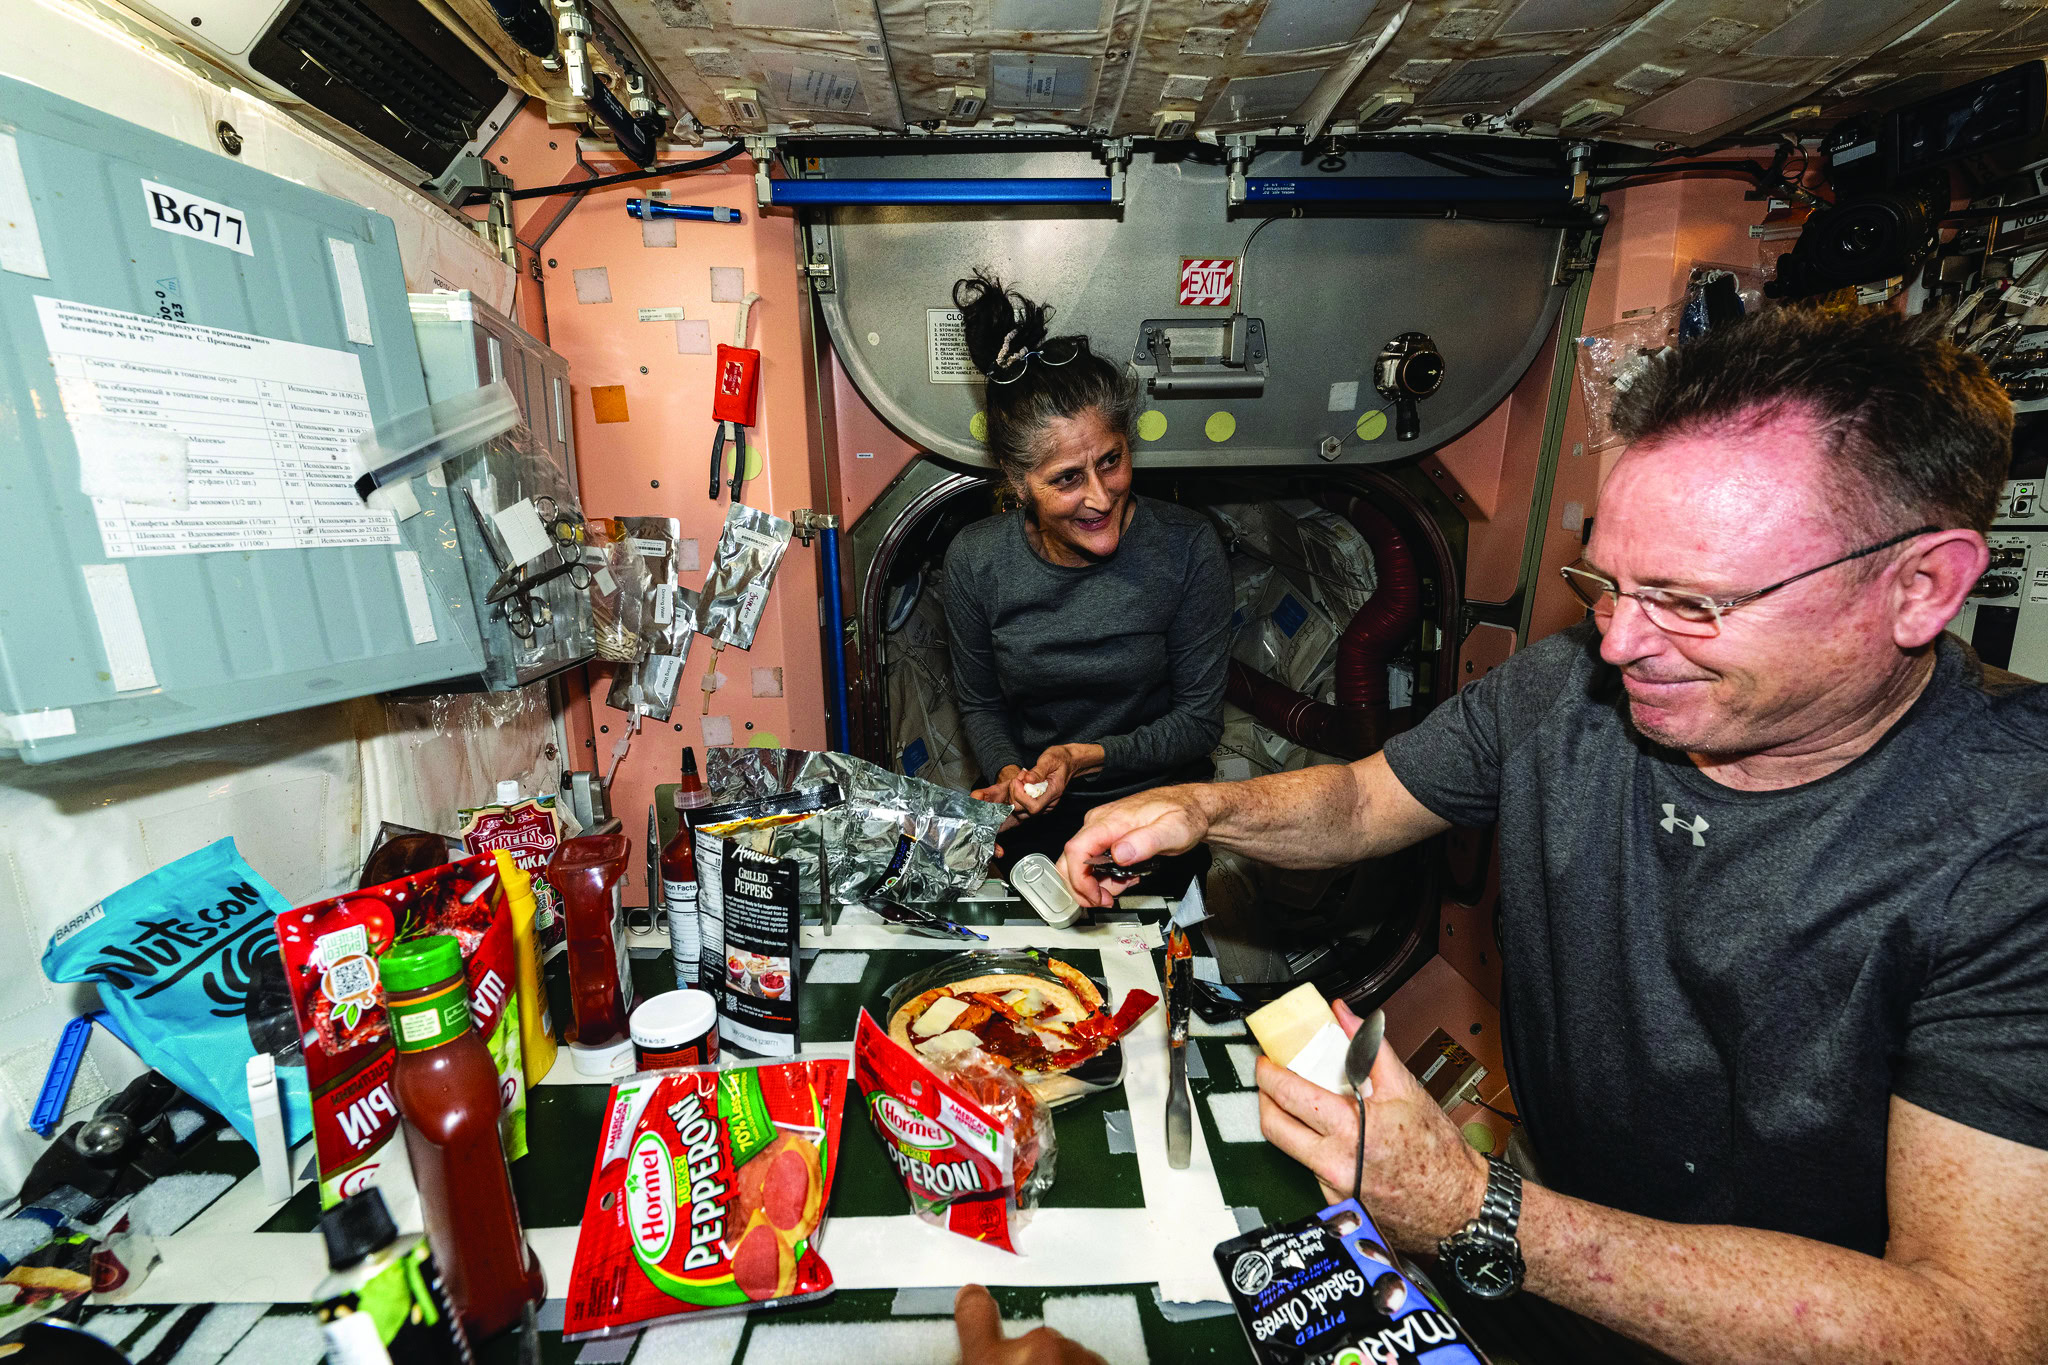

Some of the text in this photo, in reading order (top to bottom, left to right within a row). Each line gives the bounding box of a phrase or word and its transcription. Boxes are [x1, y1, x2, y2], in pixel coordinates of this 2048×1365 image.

[1829, 141, 1854, 152] Canon
[2015, 214, 2048, 229] NOD
[1188, 271, 1226, 295] EXIT
[55, 301, 270, 345] Дополнительный набор продуктов промышленного
[58, 314, 124, 330] производства
[128, 324, 142, 333] для
[144, 327, 193, 340] космонавта
[207, 337, 252, 350] Прокопьева
[61, 322, 114, 338] Контейнер
[140, 334, 154, 343] 677
[946, 313, 964, 321] CLO
[665, 660, 674, 677] Drinking
[676, 884, 697, 892] Facts
[734, 877, 774, 900] PEPPERS
[738, 866, 769, 884] GRILLED
[56, 904, 103, 941] BARRATT
[84, 882, 260, 990] Nuts.com
[324, 930, 361, 950] РЕЦЕПТ
[326, 940, 363, 961] ВИДЕО
[469, 969, 506, 1029] ША
[336, 1080, 399, 1150] ЫЙ
[731, 1094, 744, 1122] Less
[885, 1102, 942, 1141] Hormel
[950, 1103, 987, 1134] AMERICA'S
[608, 1102, 624, 1150] AMERICA'S
[733, 1120, 754, 1153] 70%
[888, 1142, 981, 1196] PPERONI
[898, 1142, 931, 1162] TURKEY
[639, 1149, 666, 1242] Hormel
[667, 1092, 727, 1271] PEPPERONI
[675, 1155, 690, 1207] TURKEY
[1302, 1268, 1365, 1316] Snack
[1252, 1298, 1308, 1342] Olives
[1296, 1310, 1347, 1346] PITTED
